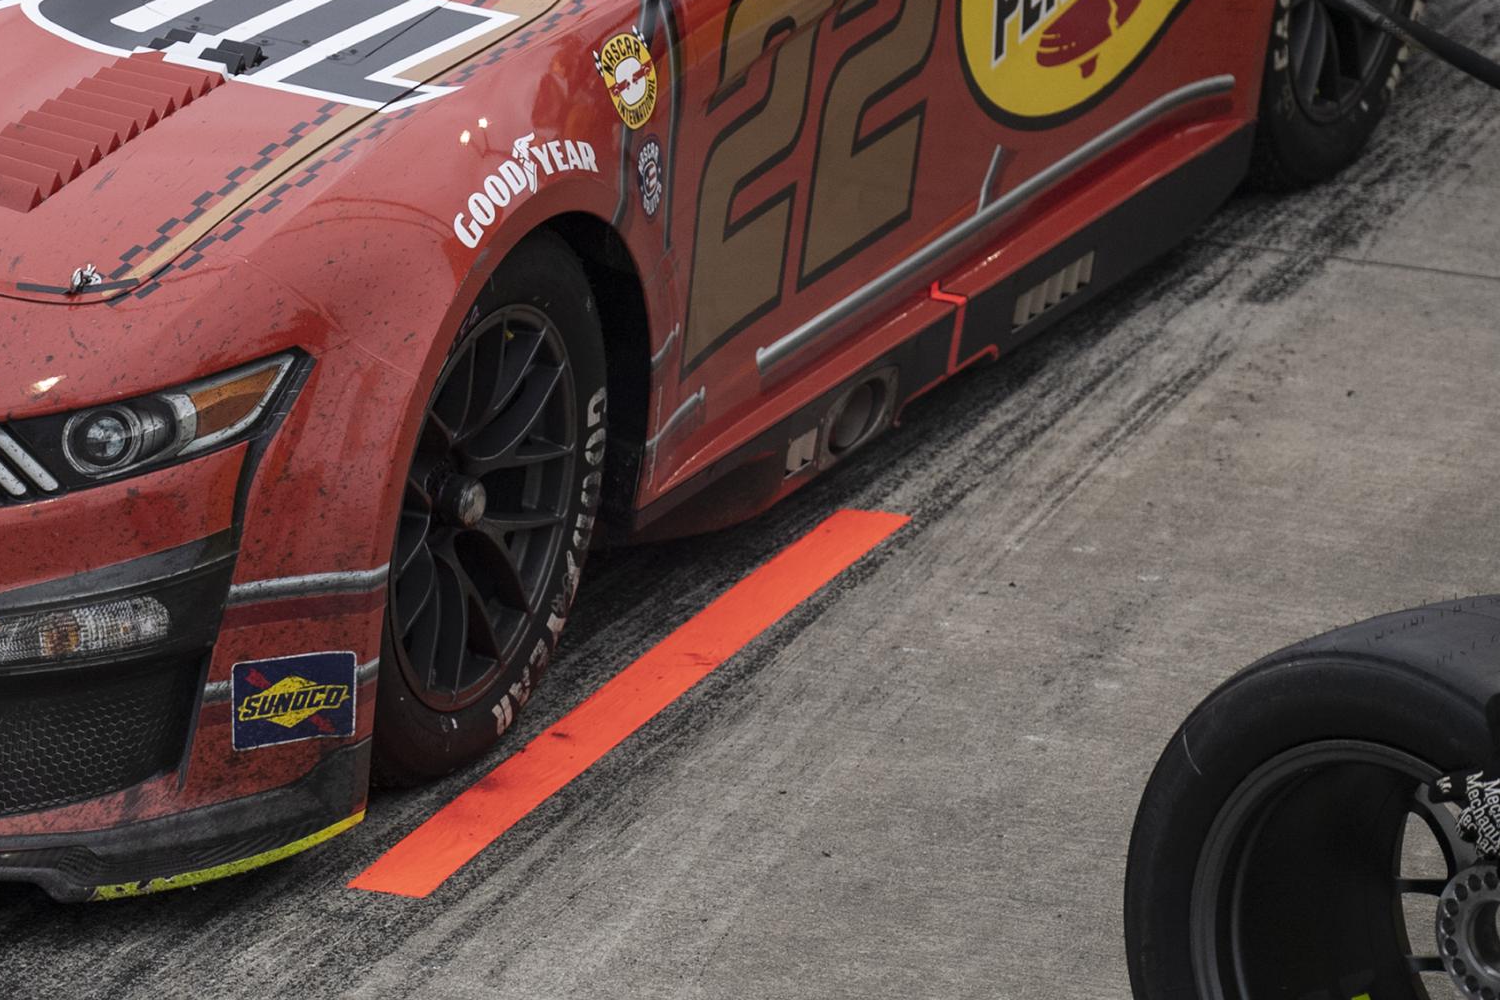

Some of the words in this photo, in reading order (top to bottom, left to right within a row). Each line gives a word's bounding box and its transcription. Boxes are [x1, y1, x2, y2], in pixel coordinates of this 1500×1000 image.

[601, 36, 643, 78] NASCAR
[616, 77, 657, 126] INTERNATIONAL
[453, 132, 599, 249] GOODYEAR
[242, 686, 345, 718] SUNOCO
